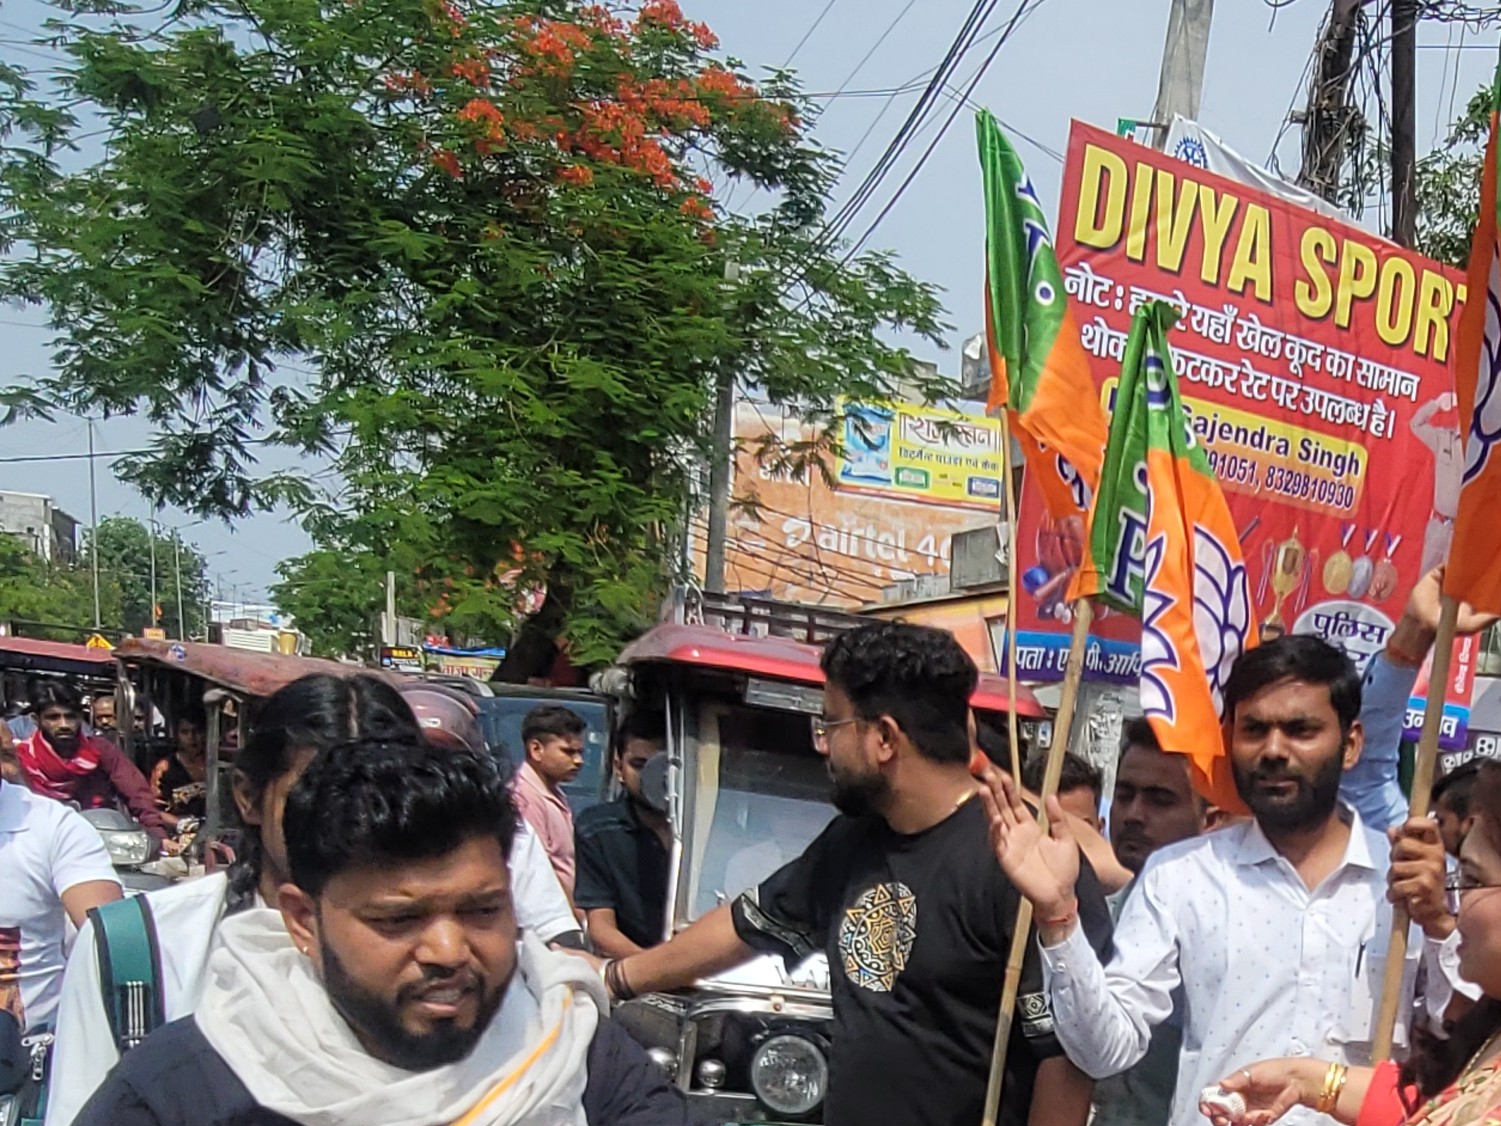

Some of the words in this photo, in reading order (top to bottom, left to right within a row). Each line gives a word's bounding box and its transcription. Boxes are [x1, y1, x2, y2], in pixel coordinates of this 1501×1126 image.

[1072, 142, 1272, 305] DIVYA
[1295, 226, 1470, 363] SPOR
[1236, 313, 1284, 361] खेल
[1284, 335, 1325, 378] कूद
[1325, 345, 1356, 382] का
[1356, 357, 1420, 403] सामान
[1270, 376, 1303, 410] पर
[1297, 437, 1361, 476] Singh
[1264, 464, 1355, 510] 8329810930
[819, 522, 909, 564] airtel
[1313, 611, 1388, 645] पुलिस
